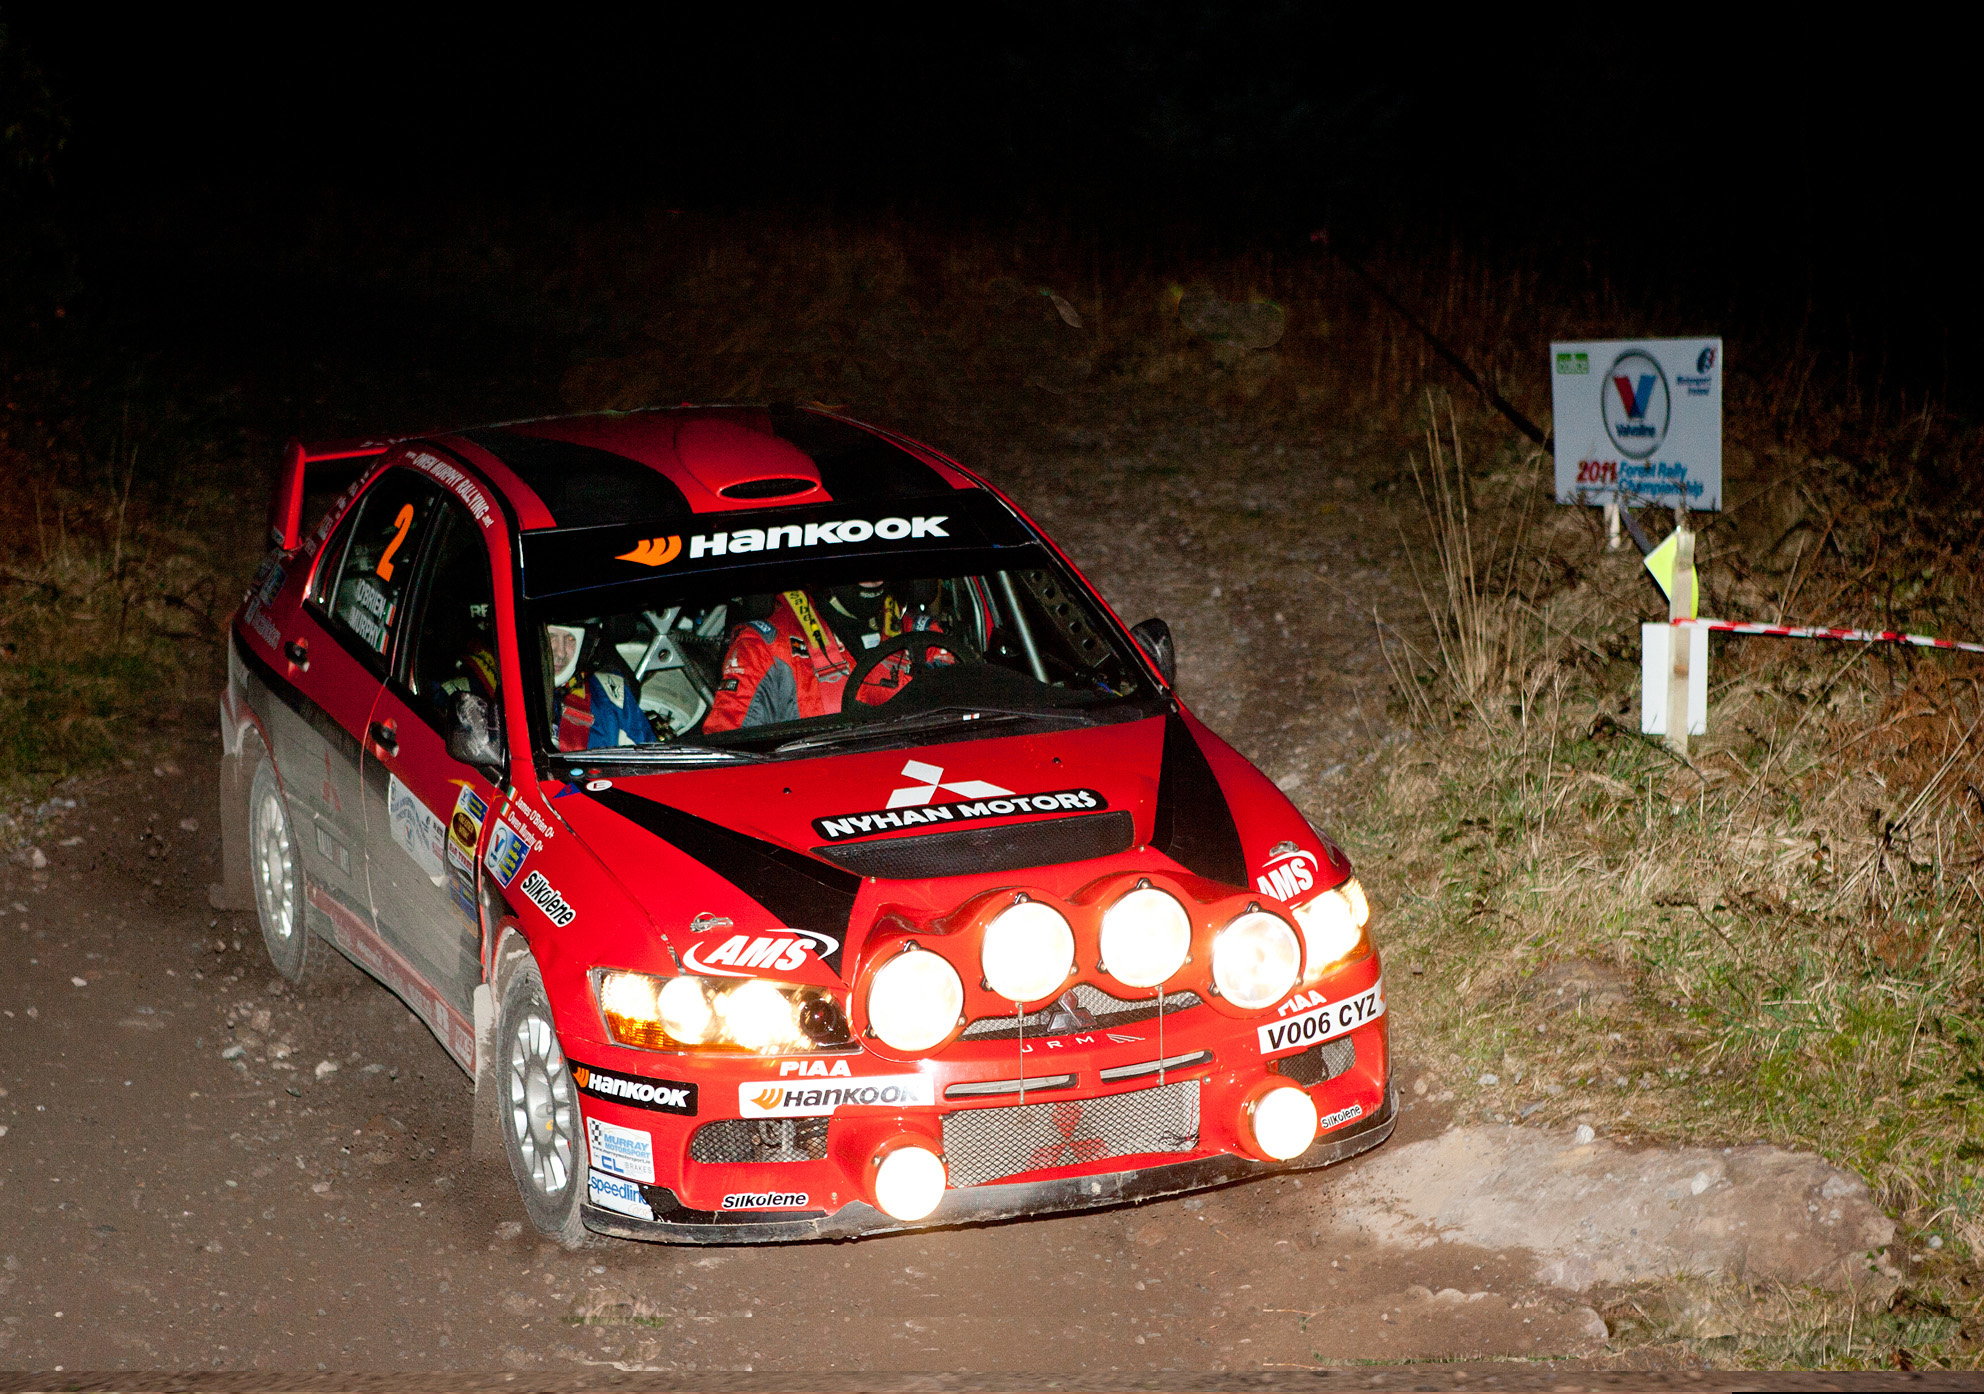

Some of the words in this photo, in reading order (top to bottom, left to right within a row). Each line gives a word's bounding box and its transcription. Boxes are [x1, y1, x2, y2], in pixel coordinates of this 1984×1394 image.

[1576, 461, 1617, 482] 2011
[1657, 462, 1688, 481] Rally
[430, 461, 465, 487] MURPHY
[455, 478, 489, 520] RALLYING
[376, 503, 414, 582] 2
[508, 811, 522, 831] Owen
[519, 823, 537, 847] Murphy
[515, 796, 532, 817] James
[529, 810, 548, 833] O'Brien
[821, 806, 954, 838] NYHAN
[956, 790, 1097, 818] MOTORS
[1256, 858, 1314, 903] AMS
[702, 935, 818, 971] AMS
[1339, 993, 1377, 1027] CYZ
[779, 1060, 852, 1077] PIAA
[604, 1133, 649, 1151] MURRAY
[604, 1142, 651, 1159] MOTORSPORT
[601, 1155, 625, 1173] CL
[625, 1161, 653, 1175] BRAKES
